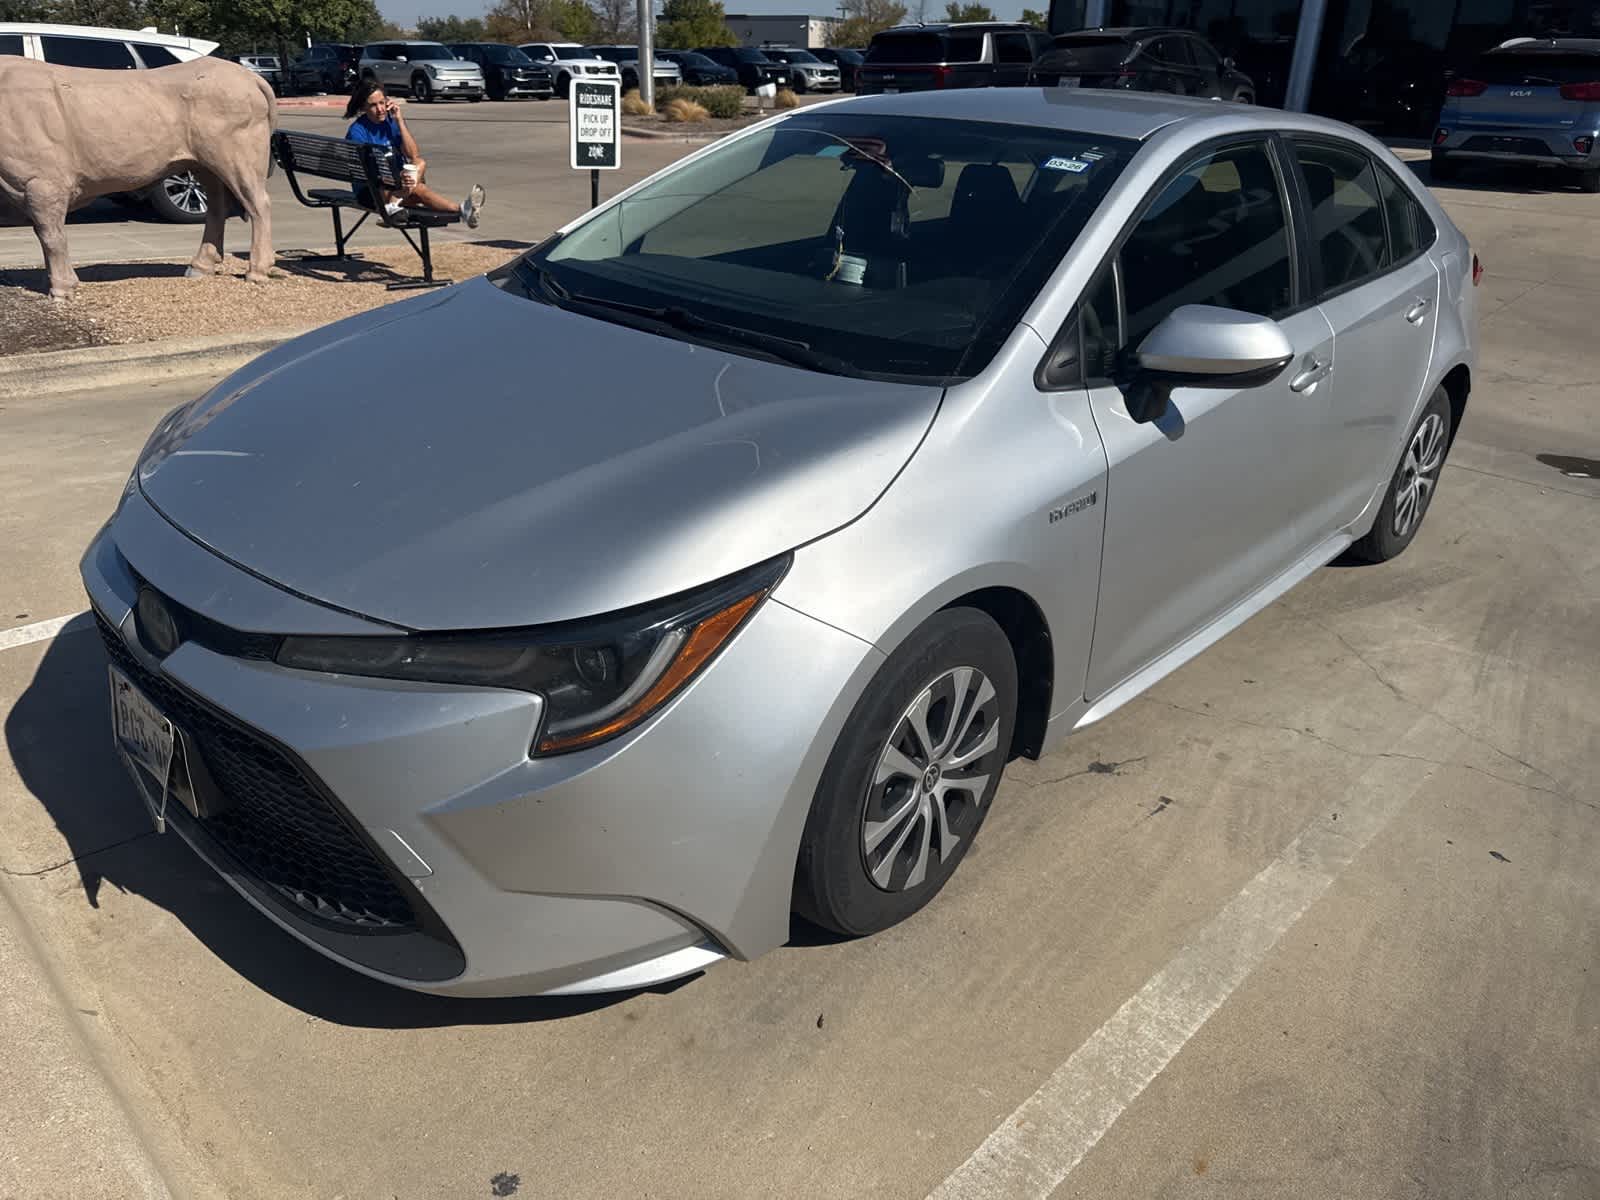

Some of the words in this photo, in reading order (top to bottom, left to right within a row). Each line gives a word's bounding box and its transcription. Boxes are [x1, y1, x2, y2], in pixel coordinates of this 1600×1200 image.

[579, 93, 613, 106] RIDESHARE
[583, 113, 599, 124] PICK
[600, 115, 609, 124] UP
[580, 127, 598, 137] DROP
[599, 128, 612, 137] OFF
[588, 145, 604, 158] ZONE
